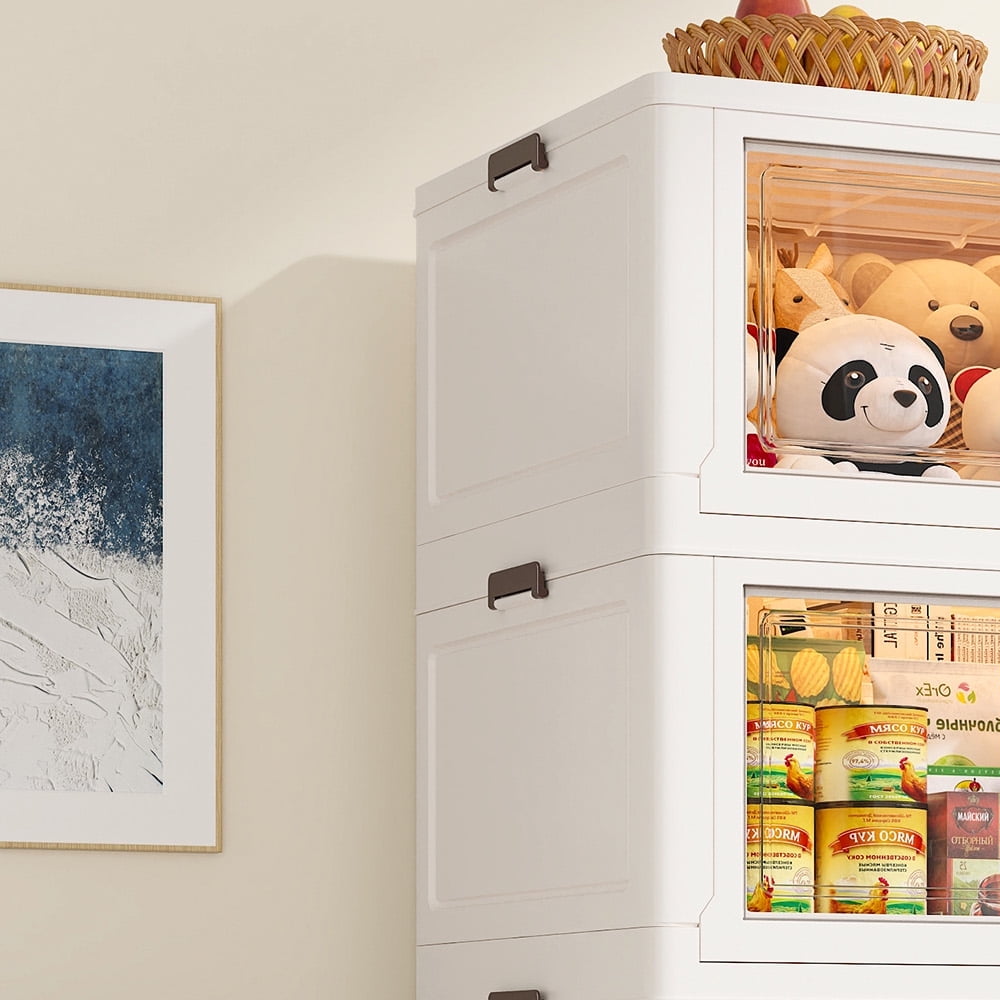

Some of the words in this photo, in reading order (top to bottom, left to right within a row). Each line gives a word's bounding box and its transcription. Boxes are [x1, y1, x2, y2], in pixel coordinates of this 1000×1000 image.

[869, 723, 908, 734] МЯСО
[910, 725, 926, 736] КУР
[956, 810, 990, 822] МАЙСКИЙ
[951, 834, 994, 846] ОТБОРНЫЙ
